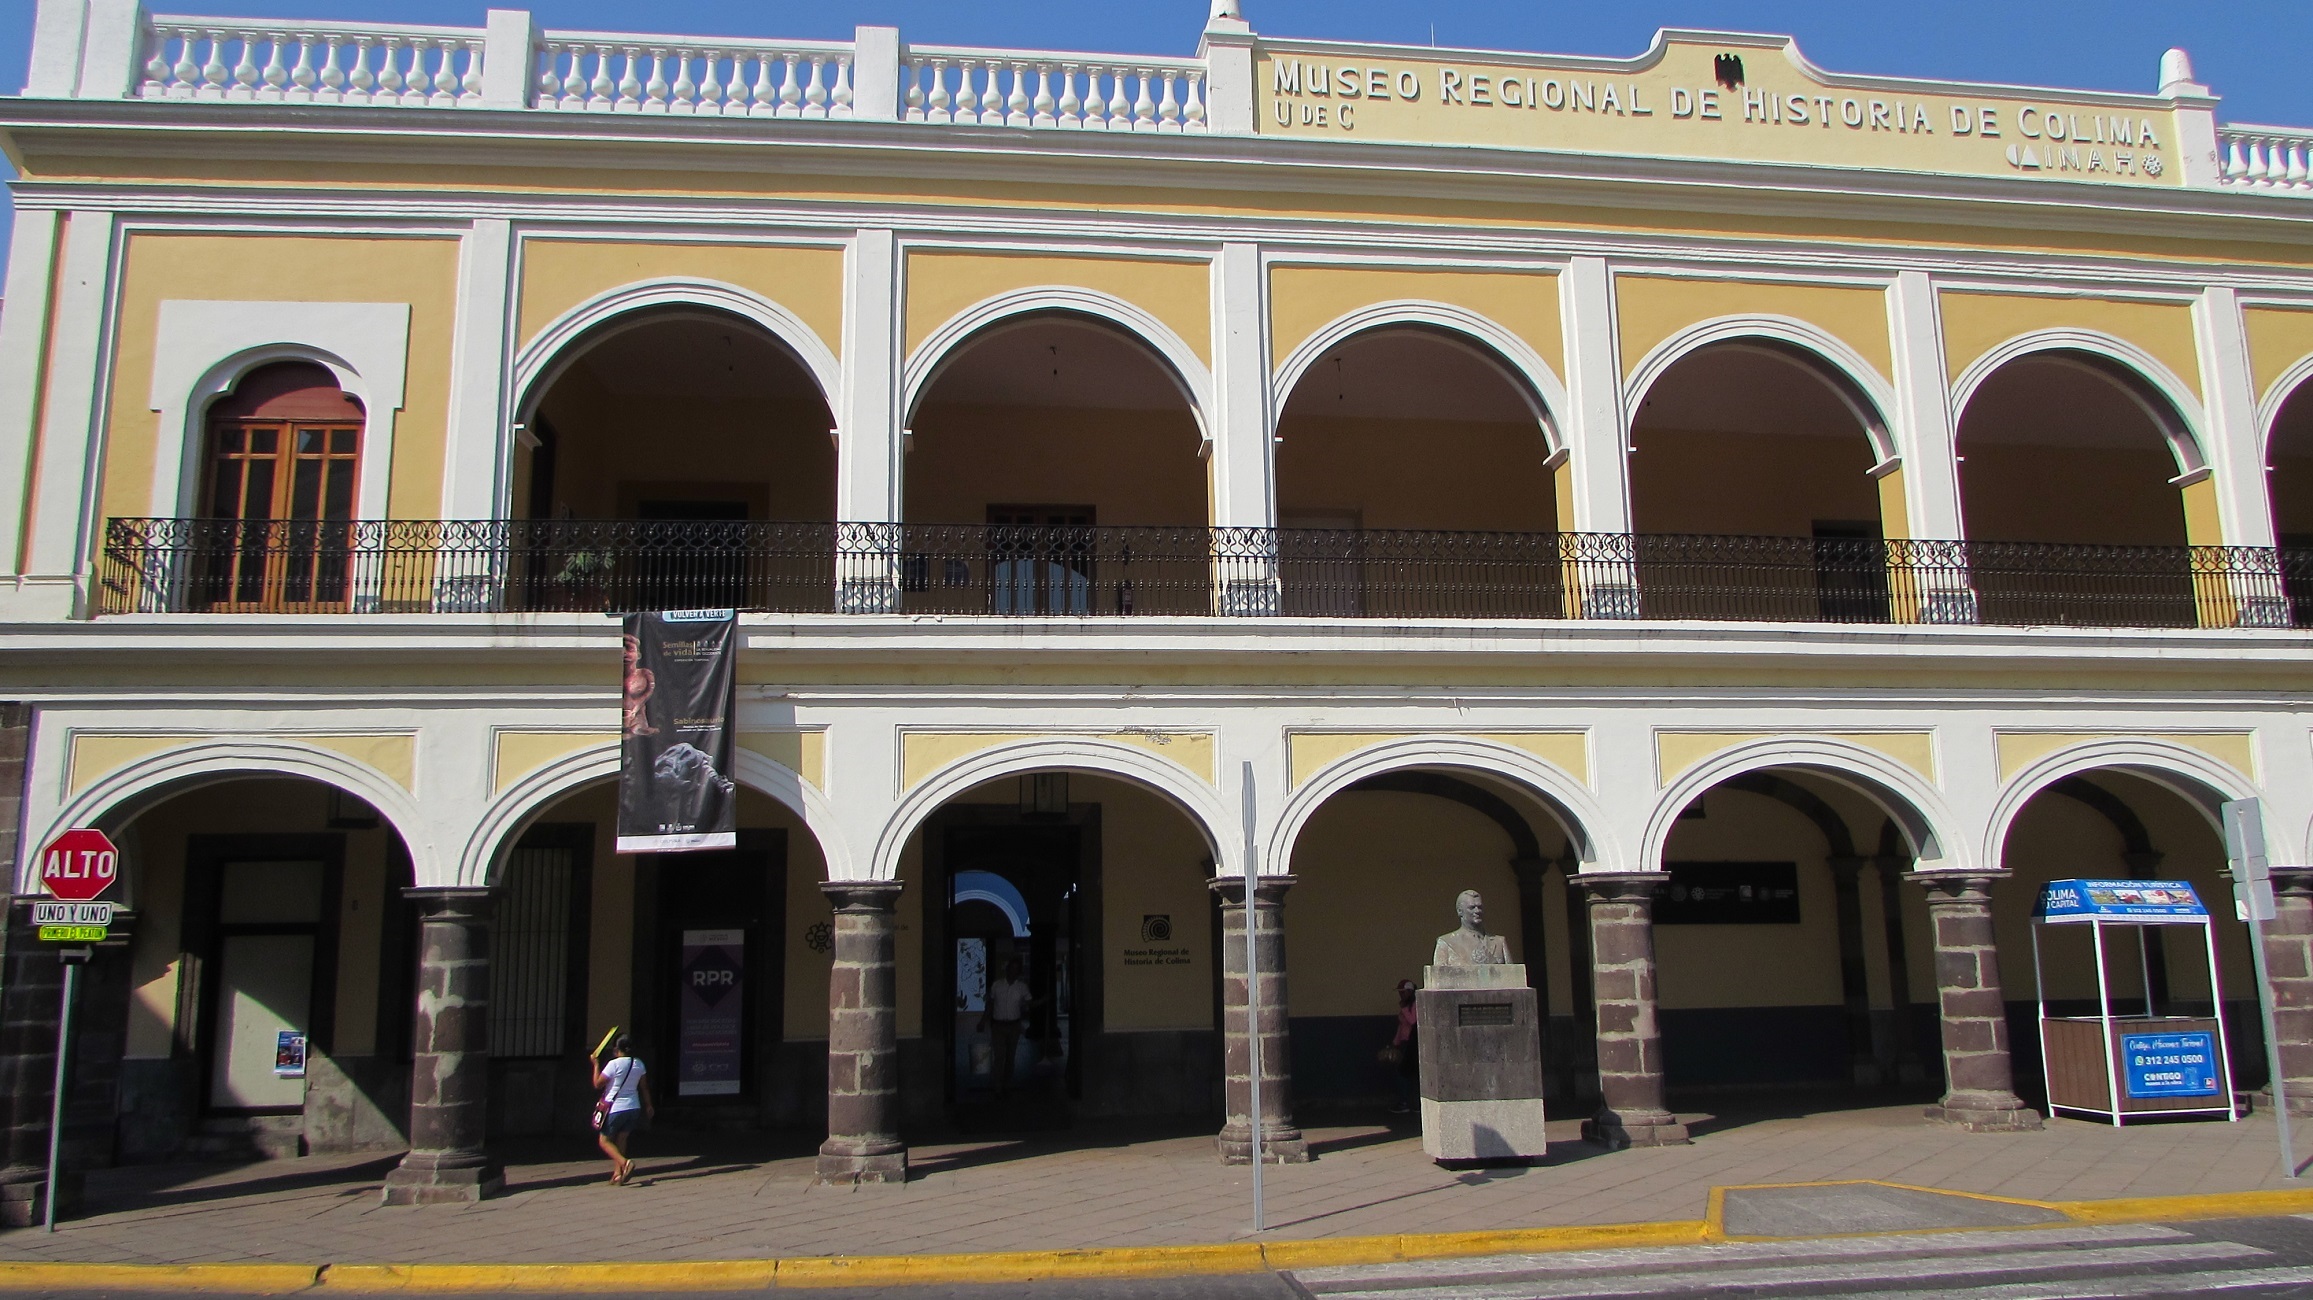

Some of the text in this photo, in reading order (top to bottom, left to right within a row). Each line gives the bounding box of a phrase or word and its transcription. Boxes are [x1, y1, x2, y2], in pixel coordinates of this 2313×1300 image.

[1273, 58, 2159, 146] MUSEO REGIONAL DE HISTORIA DE COLIMA
[1274, 100, 1354, 129] U DE C
[2044, 145, 2136, 175] INAH
[44, 850, 115, 878] ALTO
[38, 904, 107, 921] UNO Y UNO
[1149, 948, 1178, 957] Regional
[693, 970, 734, 986] RPR
[2145, 1054, 2203, 1065] 312 245 0500
